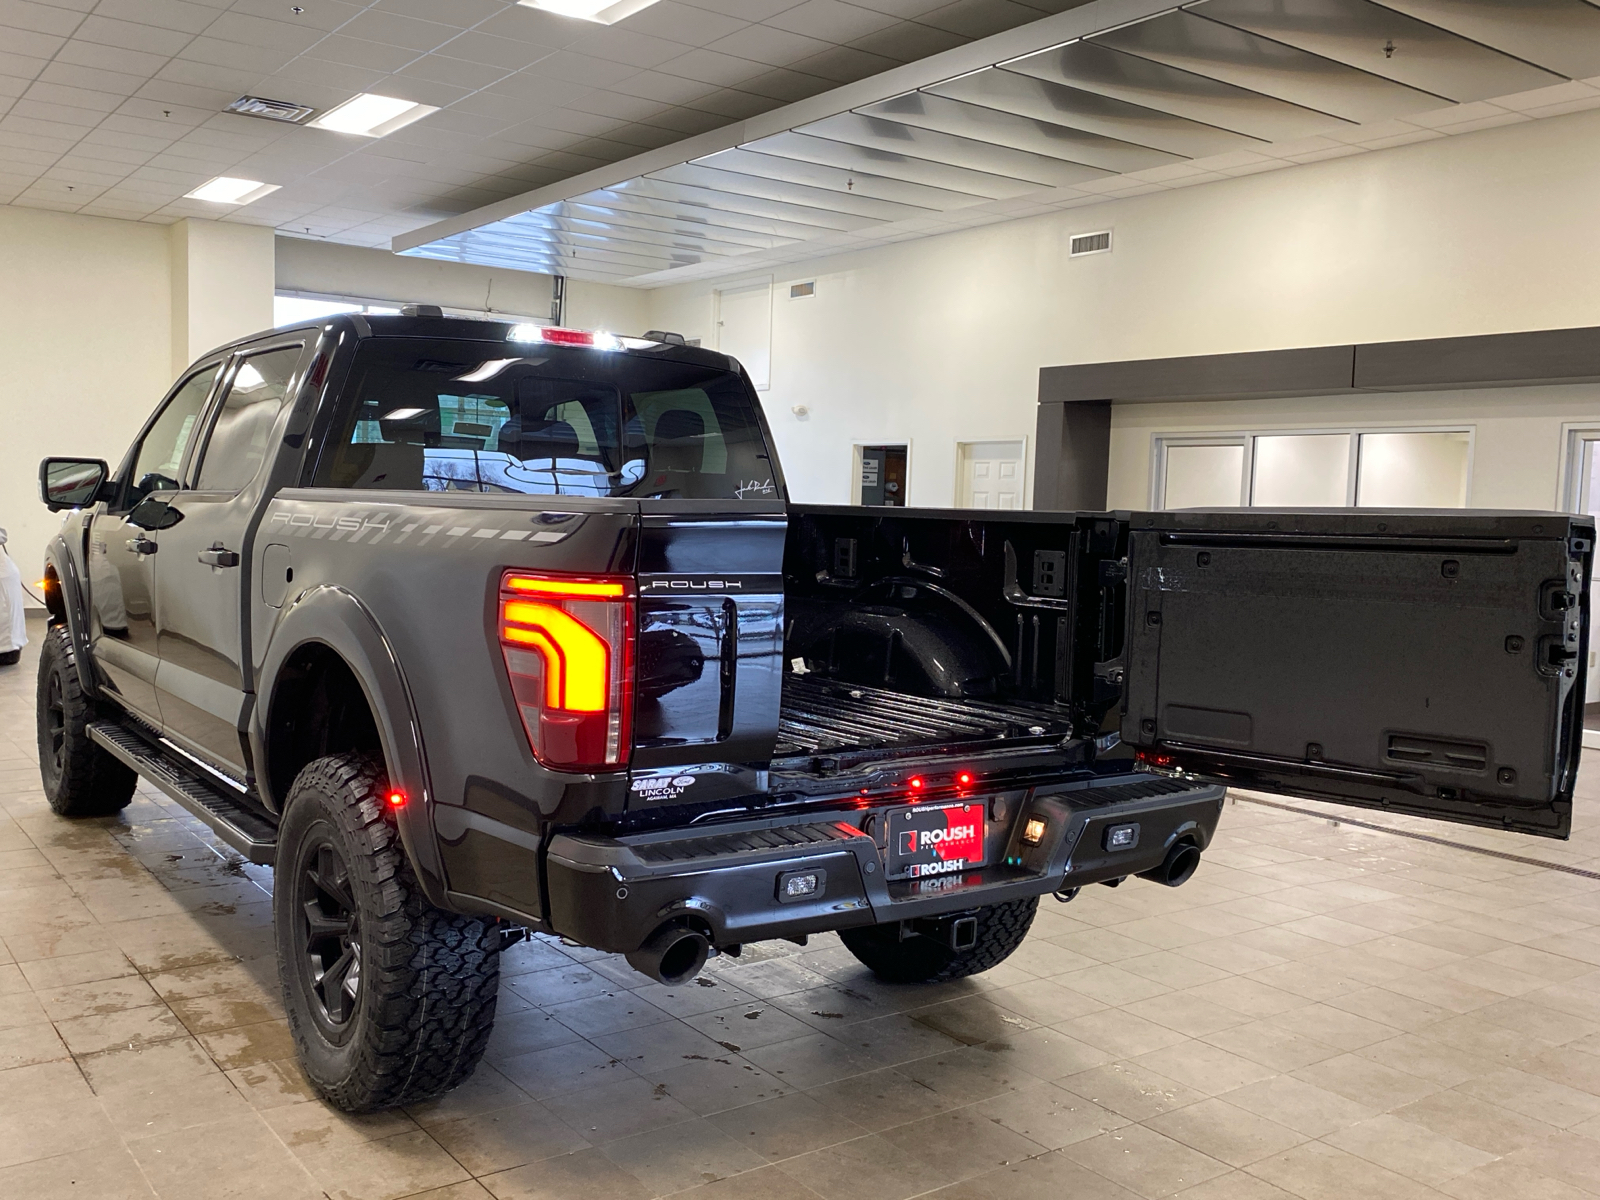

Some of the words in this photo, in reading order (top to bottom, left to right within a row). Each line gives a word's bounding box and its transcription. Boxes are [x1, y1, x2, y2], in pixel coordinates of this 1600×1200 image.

[270, 512, 390, 532] ROUSH
[652, 580, 741, 588] ROUSH
[631, 777, 672, 791] SARAT
[639, 787, 684, 797] LINCOLN
[920, 825, 974, 845] ROUSH
[920, 839, 974, 850] PERFORMANCE
[921, 859, 963, 876] ROUSH
